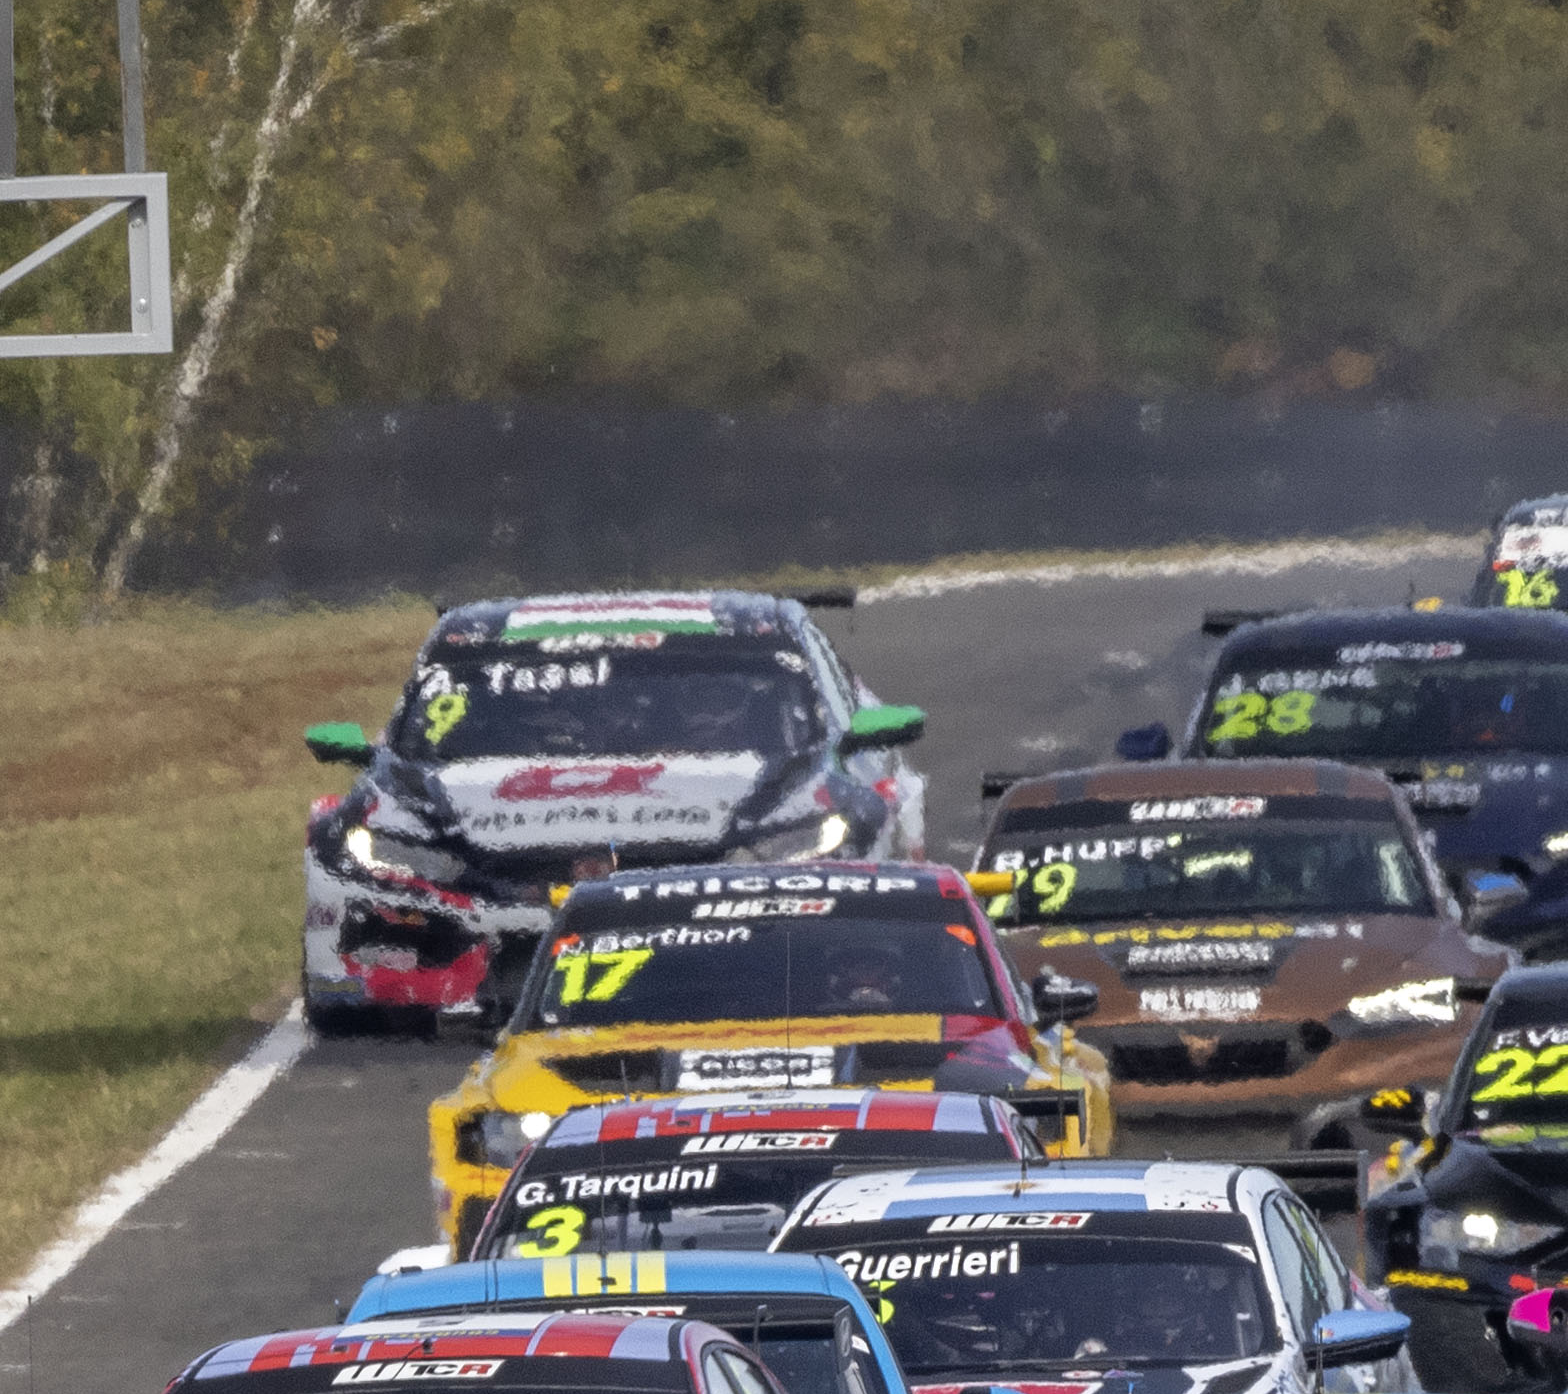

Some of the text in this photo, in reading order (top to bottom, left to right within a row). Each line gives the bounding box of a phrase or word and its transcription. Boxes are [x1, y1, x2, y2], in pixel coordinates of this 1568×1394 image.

[424, 693, 469, 746] 9
[1206, 690, 1317, 743] 28
[554, 946, 655, 1007] 17
[680, 1132, 841, 1156] WTCR
[516, 1162, 720, 1207] G. Tarquini
[518, 1205, 588, 1259] 3
[926, 1211, 1095, 1234] WTCR
[835, 1241, 1021, 1283] Guerrieri
[332, 1359, 507, 1385] WTCR
